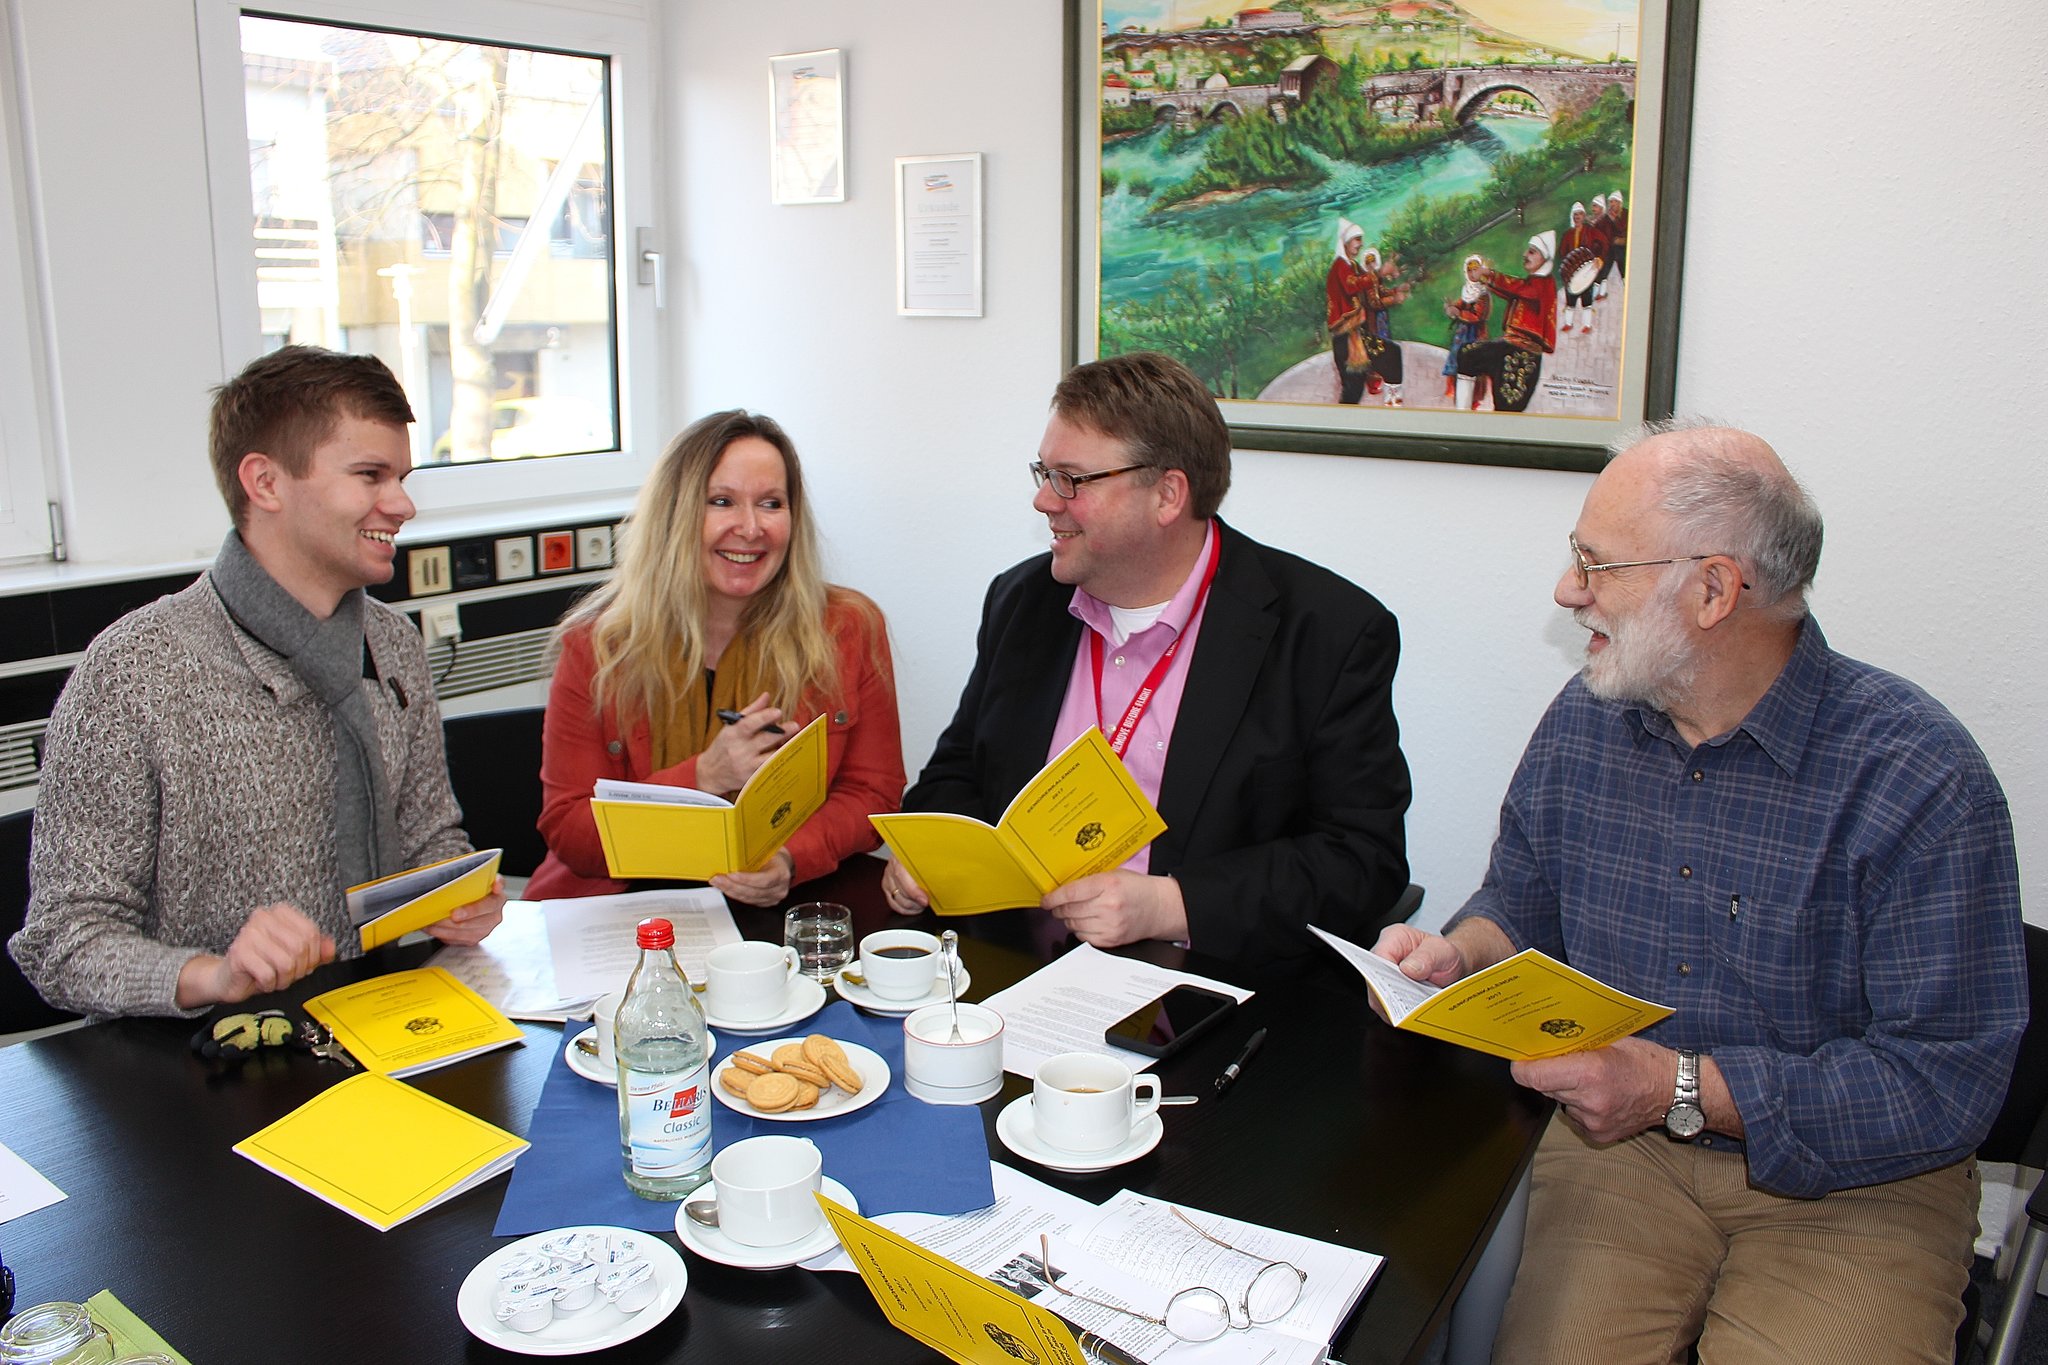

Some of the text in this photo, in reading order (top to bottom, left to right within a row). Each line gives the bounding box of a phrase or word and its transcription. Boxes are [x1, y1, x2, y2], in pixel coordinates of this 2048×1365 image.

[546, 326, 561, 348] 2
[1112, 688, 1153, 754] REMOVE BEFORE FLIGHT
[1448, 975, 1520, 1011] SENIORENKALENDER
[653, 1087, 707, 1112] BELLARIS
[663, 1116, 701, 1134] Classic
[860, 1242, 908, 1312] SENIORENKALENDER
[893, 1277, 908, 1295] 2017
